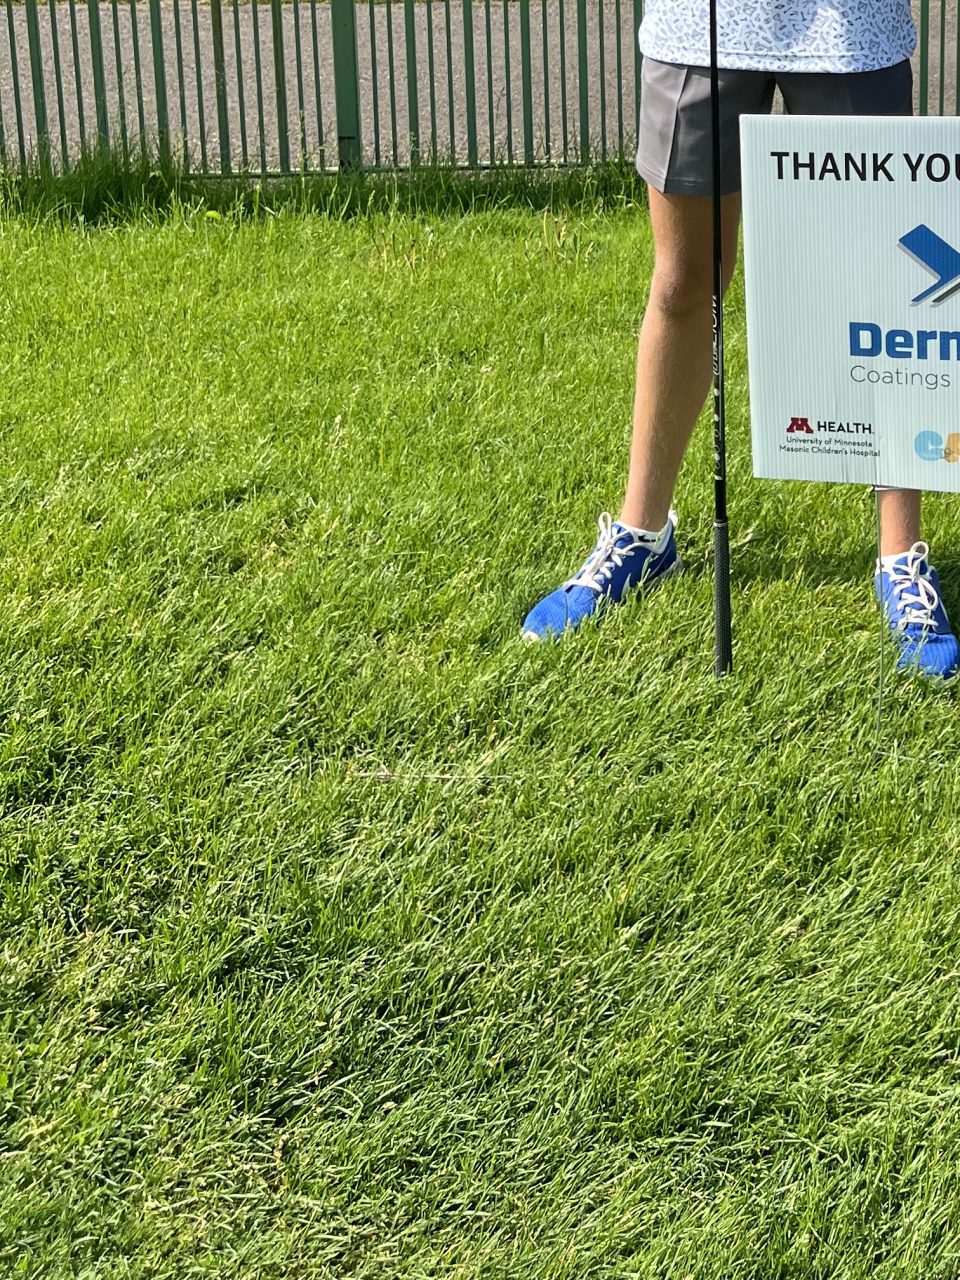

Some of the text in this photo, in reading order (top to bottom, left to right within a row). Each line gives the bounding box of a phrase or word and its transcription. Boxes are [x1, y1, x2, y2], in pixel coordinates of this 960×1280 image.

[770, 151, 895, 182] THANK
[850, 365, 951, 390] Coatings
[786, 436, 822, 445] University
[834, 438, 872, 447] Minnesota
[779, 445, 880, 457] Masonic Children's Hospital
